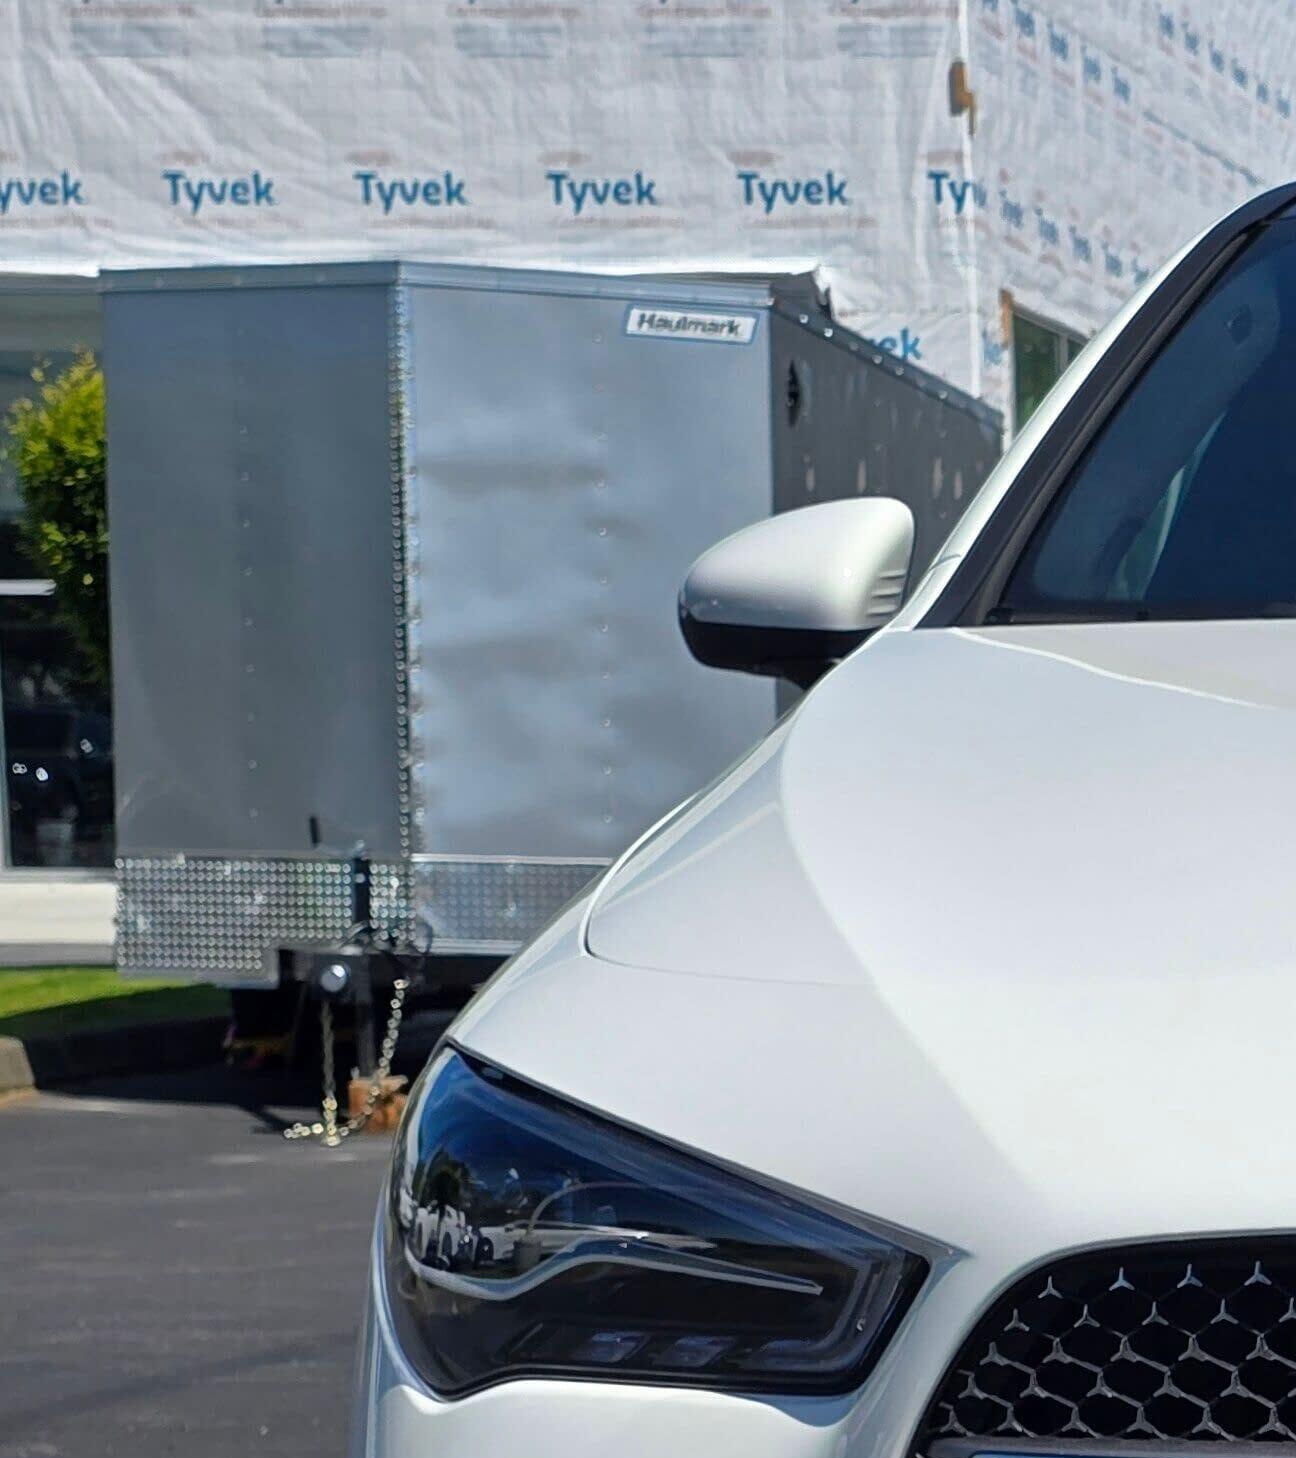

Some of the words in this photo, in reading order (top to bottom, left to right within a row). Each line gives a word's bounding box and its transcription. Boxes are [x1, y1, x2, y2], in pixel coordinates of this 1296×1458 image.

[163, 169, 278, 216] Tyvek
[354, 169, 469, 216] Tyvek
[546, 169, 658, 216] Tyvek
[737, 169, 849, 215] Tyvek
[637, 312, 740, 337] Haulmark
